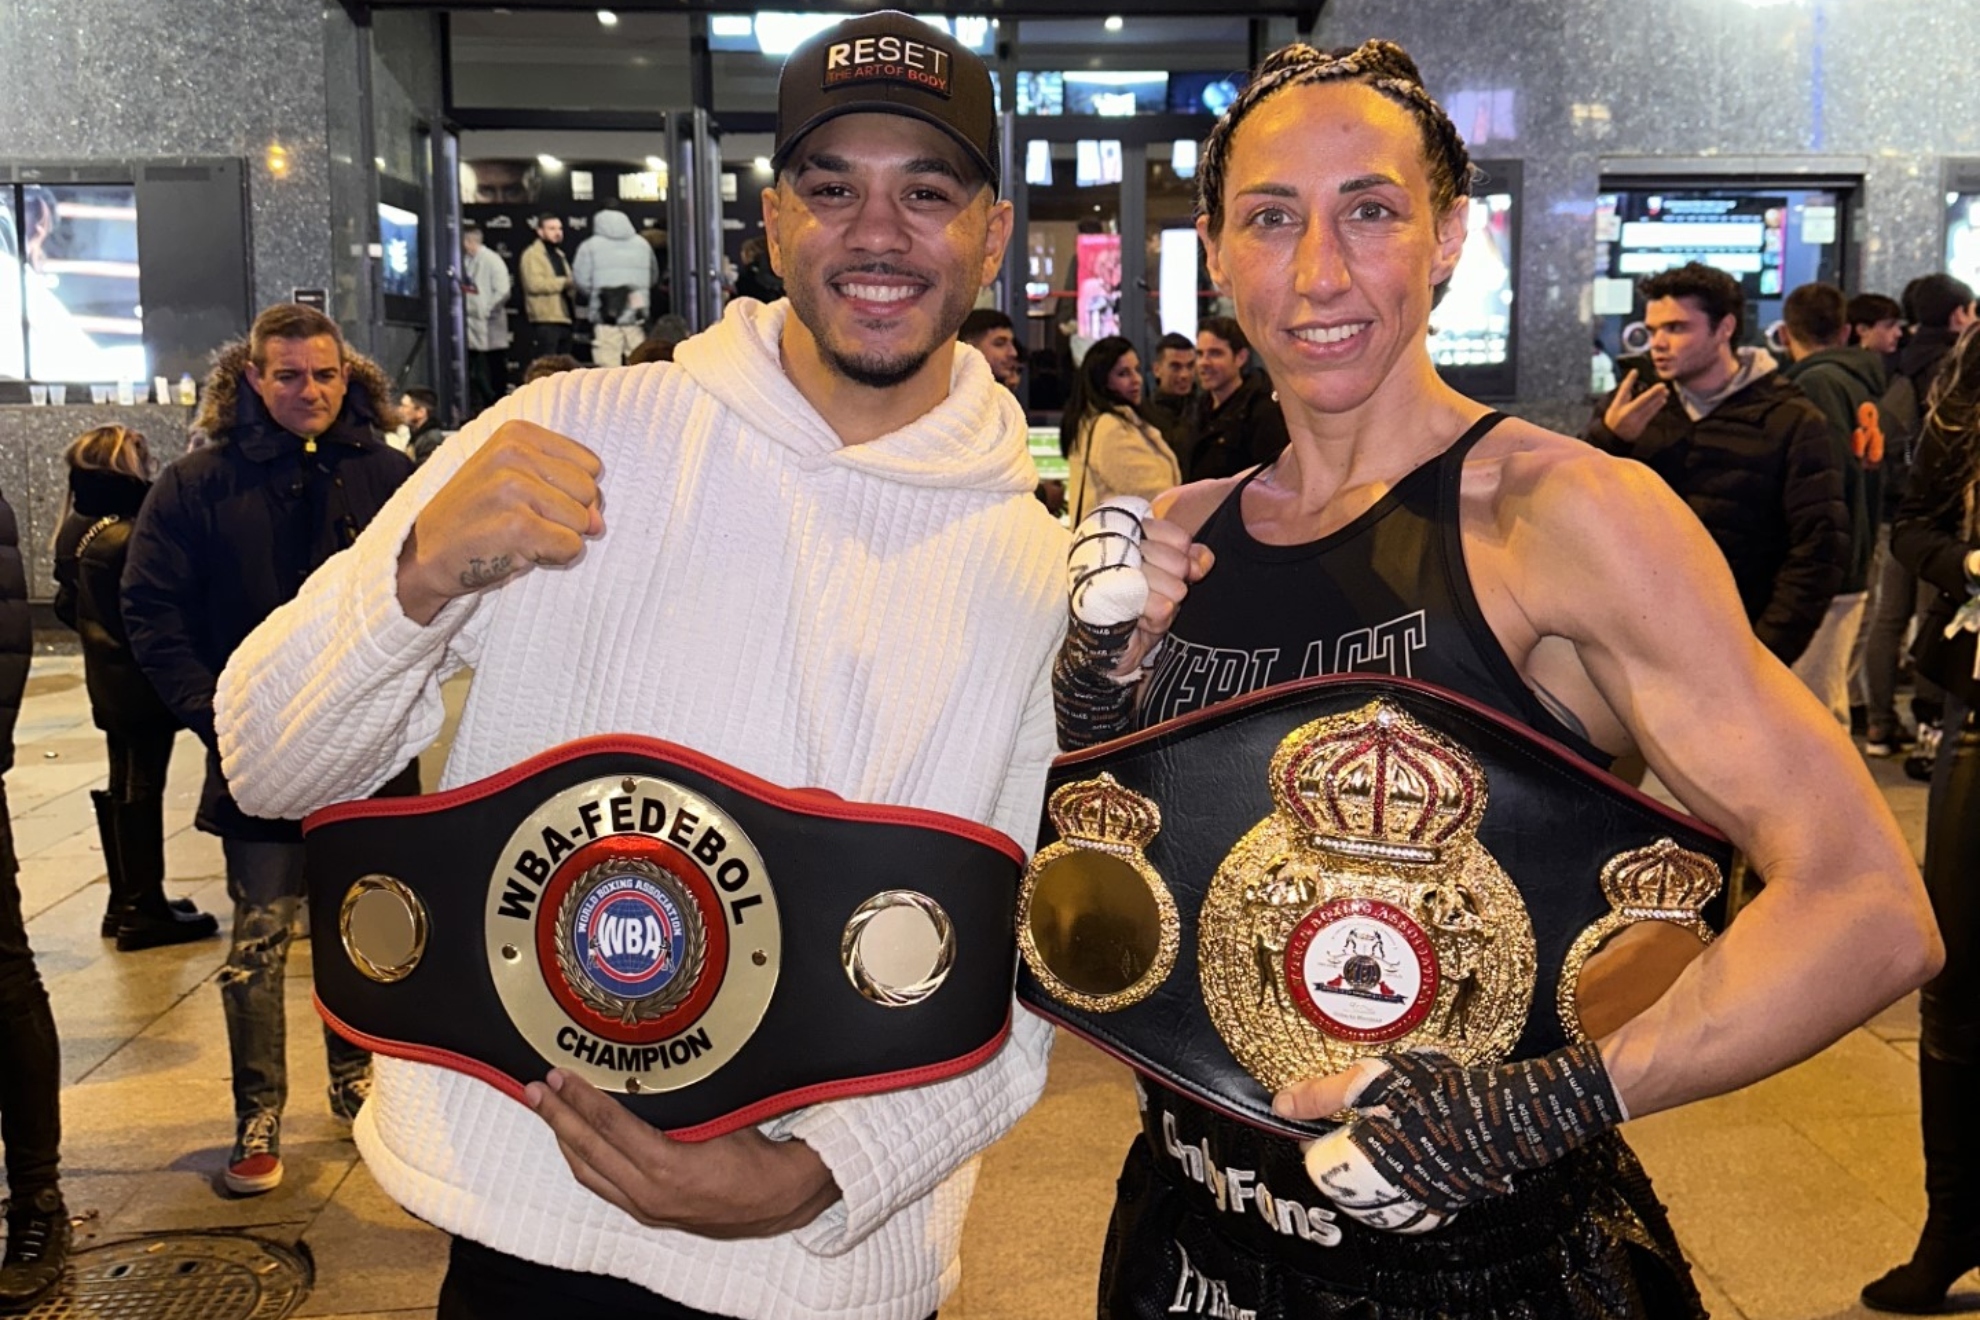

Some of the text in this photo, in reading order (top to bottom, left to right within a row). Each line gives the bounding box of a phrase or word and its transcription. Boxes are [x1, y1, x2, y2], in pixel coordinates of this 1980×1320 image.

[828, 36, 948, 74] RESET
[827, 64, 947, 90] THE ART OF BODY
[497, 796, 763, 925] WBA-FEDEBOL
[578, 879, 682, 936] WORLD BOXING ASSOCIATION
[1311, 901, 1373, 928] BOXING
[597, 912, 662, 960] WBA
[556, 1026, 713, 1072] CHAMPION
[1556, 1056, 1571, 1076] tape
[1525, 1072, 1539, 1094] gym
[1567, 1077, 1585, 1097] gym
[1486, 1090, 1502, 1126] empire
[1502, 1087, 1512, 1111] tape
[1547, 1093, 1561, 1115] tape
[1508, 1112, 1522, 1132] gym
[1517, 1102, 1531, 1125] tape
[1464, 1127, 1479, 1149] tape
[1477, 1120, 1492, 1141] gym
[1527, 1125, 1542, 1142] gym
[1366, 1135, 1388, 1157] tape
[1418, 1134, 1437, 1157] tape
[1384, 1154, 1406, 1173] gym
